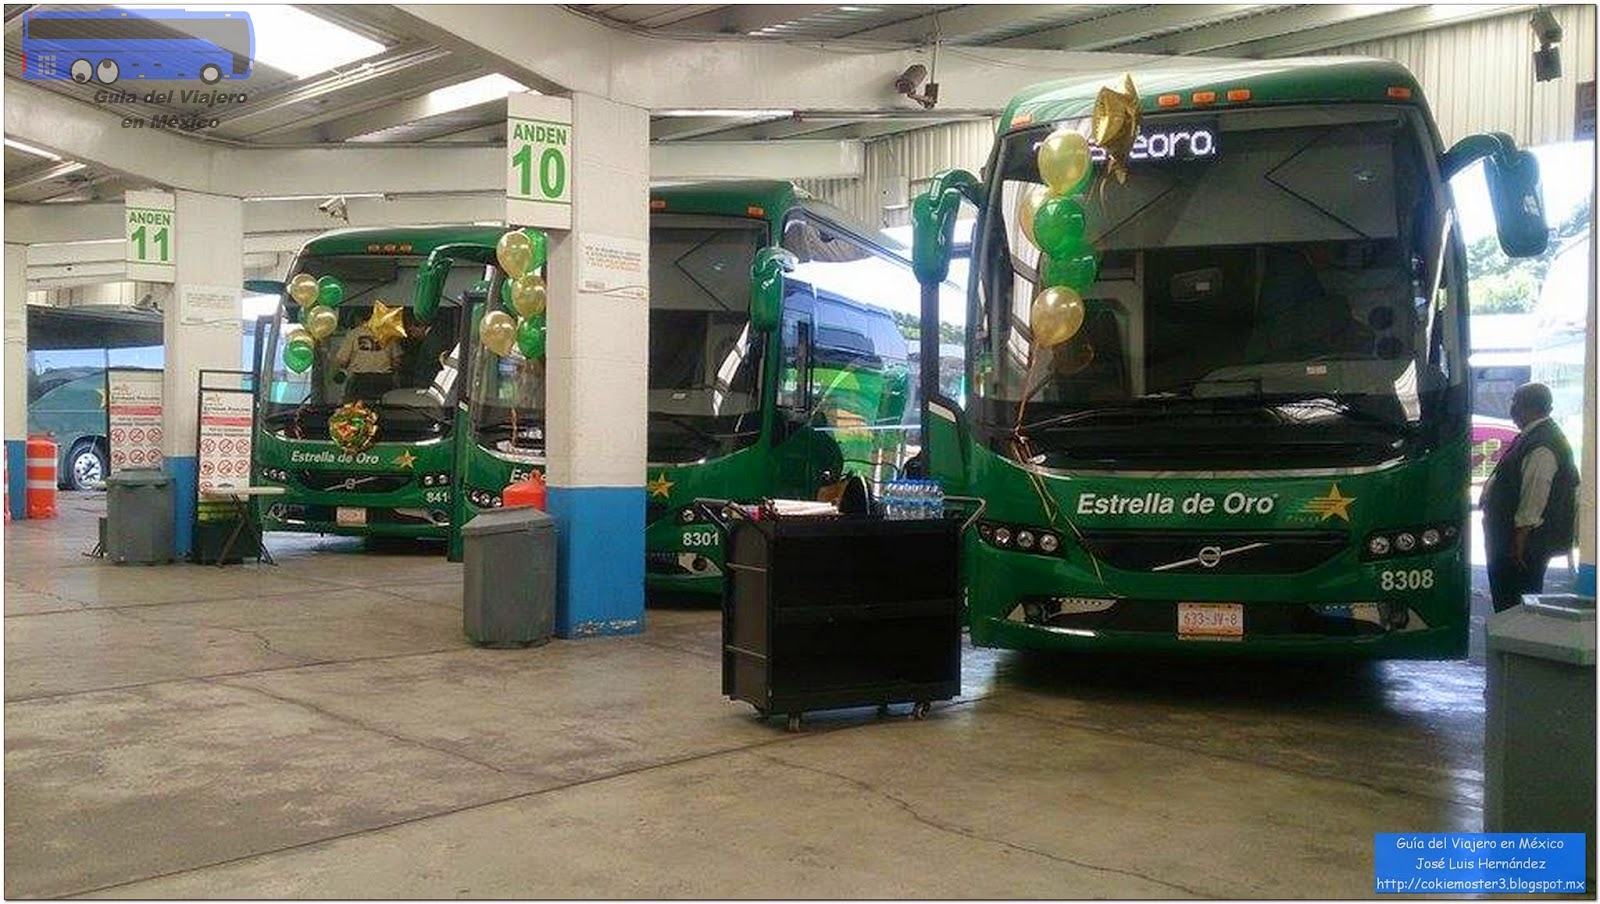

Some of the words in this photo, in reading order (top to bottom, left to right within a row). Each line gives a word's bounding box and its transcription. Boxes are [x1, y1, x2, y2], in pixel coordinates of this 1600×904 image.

[512, 124, 567, 146] ANDEN
[512, 144, 566, 198] 10
[129, 211, 170, 226] ANDEN
[131, 226, 168, 262] 11
[291, 450, 335, 463] Estrella
[338, 451, 353, 464] de
[356, 452, 379, 465] Oro
[425, 491, 452, 503] 841
[1077, 492, 1174, 515] Estrella
[1181, 492, 1215, 515] de
[1223, 491, 1275, 515] Oro
[682, 532, 719, 546] 8301
[1381, 569, 1435, 590] 8308
